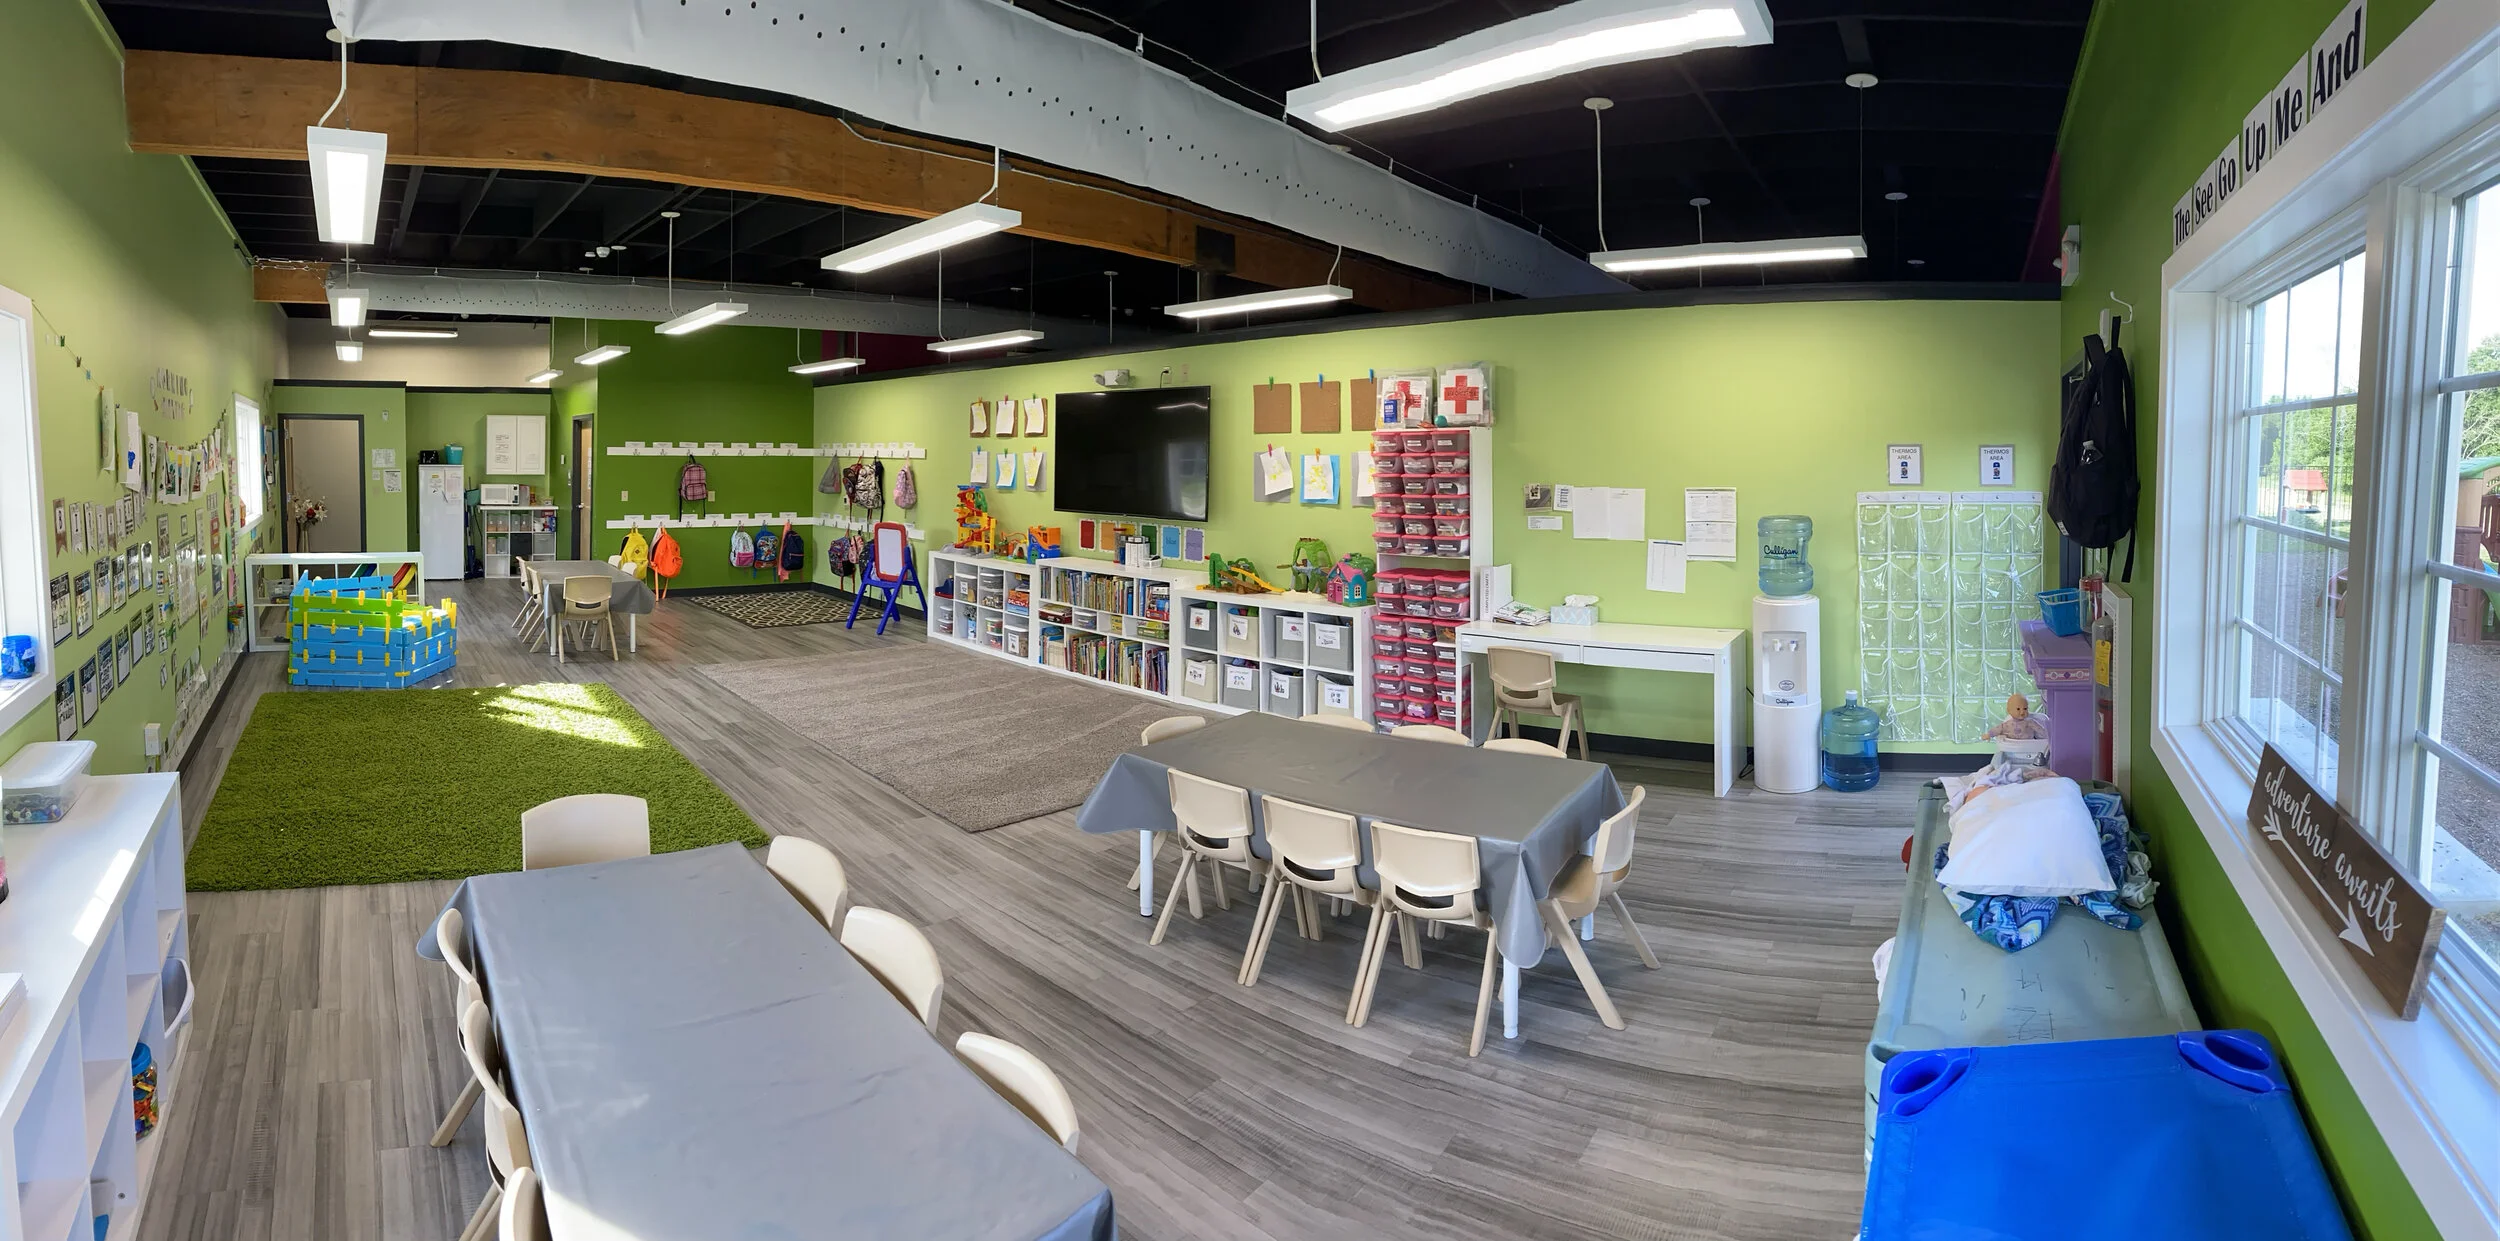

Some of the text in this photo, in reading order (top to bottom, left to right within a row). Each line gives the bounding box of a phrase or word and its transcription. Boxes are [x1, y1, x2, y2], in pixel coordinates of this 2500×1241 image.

[2174, 6, 2362, 246] The See Go Up Me And
[1764, 544, 1799, 559] Culligan
[2264, 765, 2402, 942] adventure awaits
